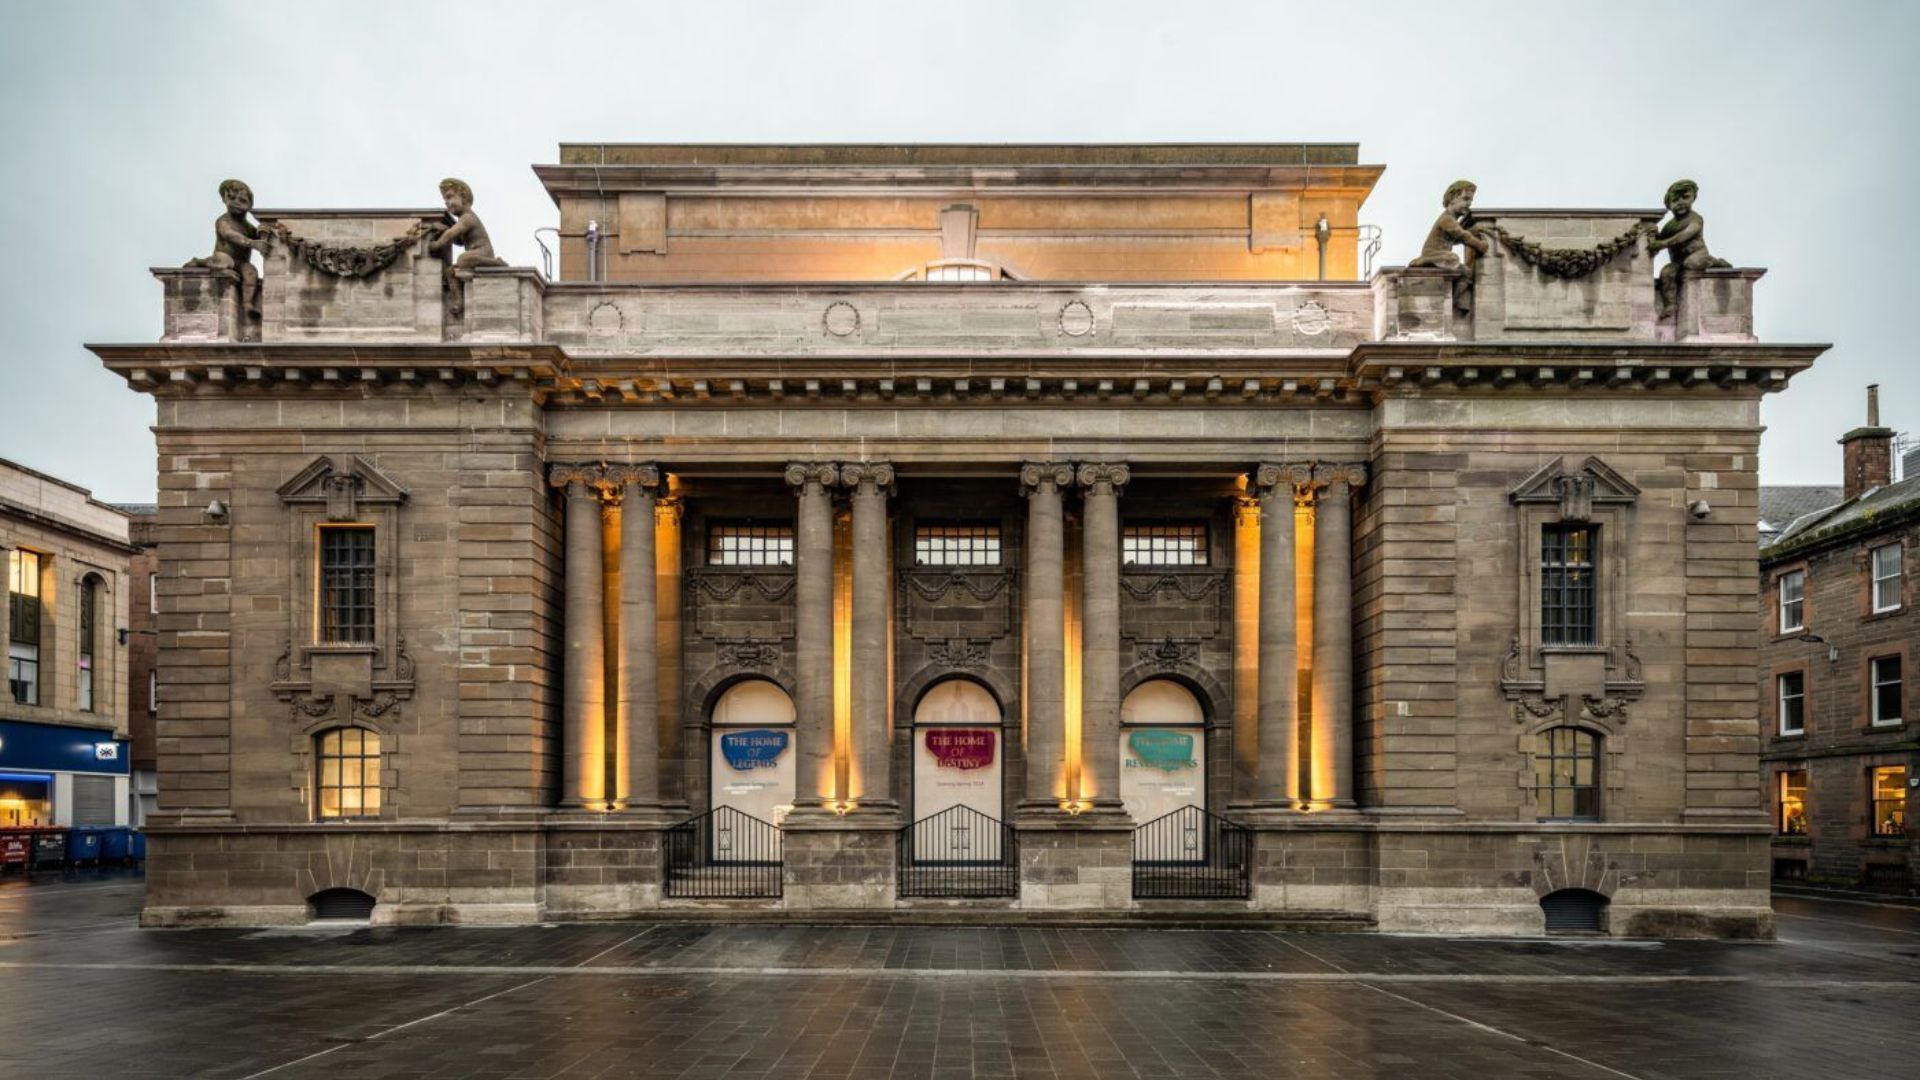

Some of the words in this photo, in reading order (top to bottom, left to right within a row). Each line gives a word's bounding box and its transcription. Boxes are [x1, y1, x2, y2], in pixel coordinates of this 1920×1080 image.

[728, 736, 748, 746] THE
[751, 736, 782, 746] HOME
[932, 736, 952, 745] THE
[954, 736, 986, 745] HOME
[747, 748, 761, 758] OF
[951, 748, 965, 757] OF
[732, 759, 778, 768] LEGENDS
